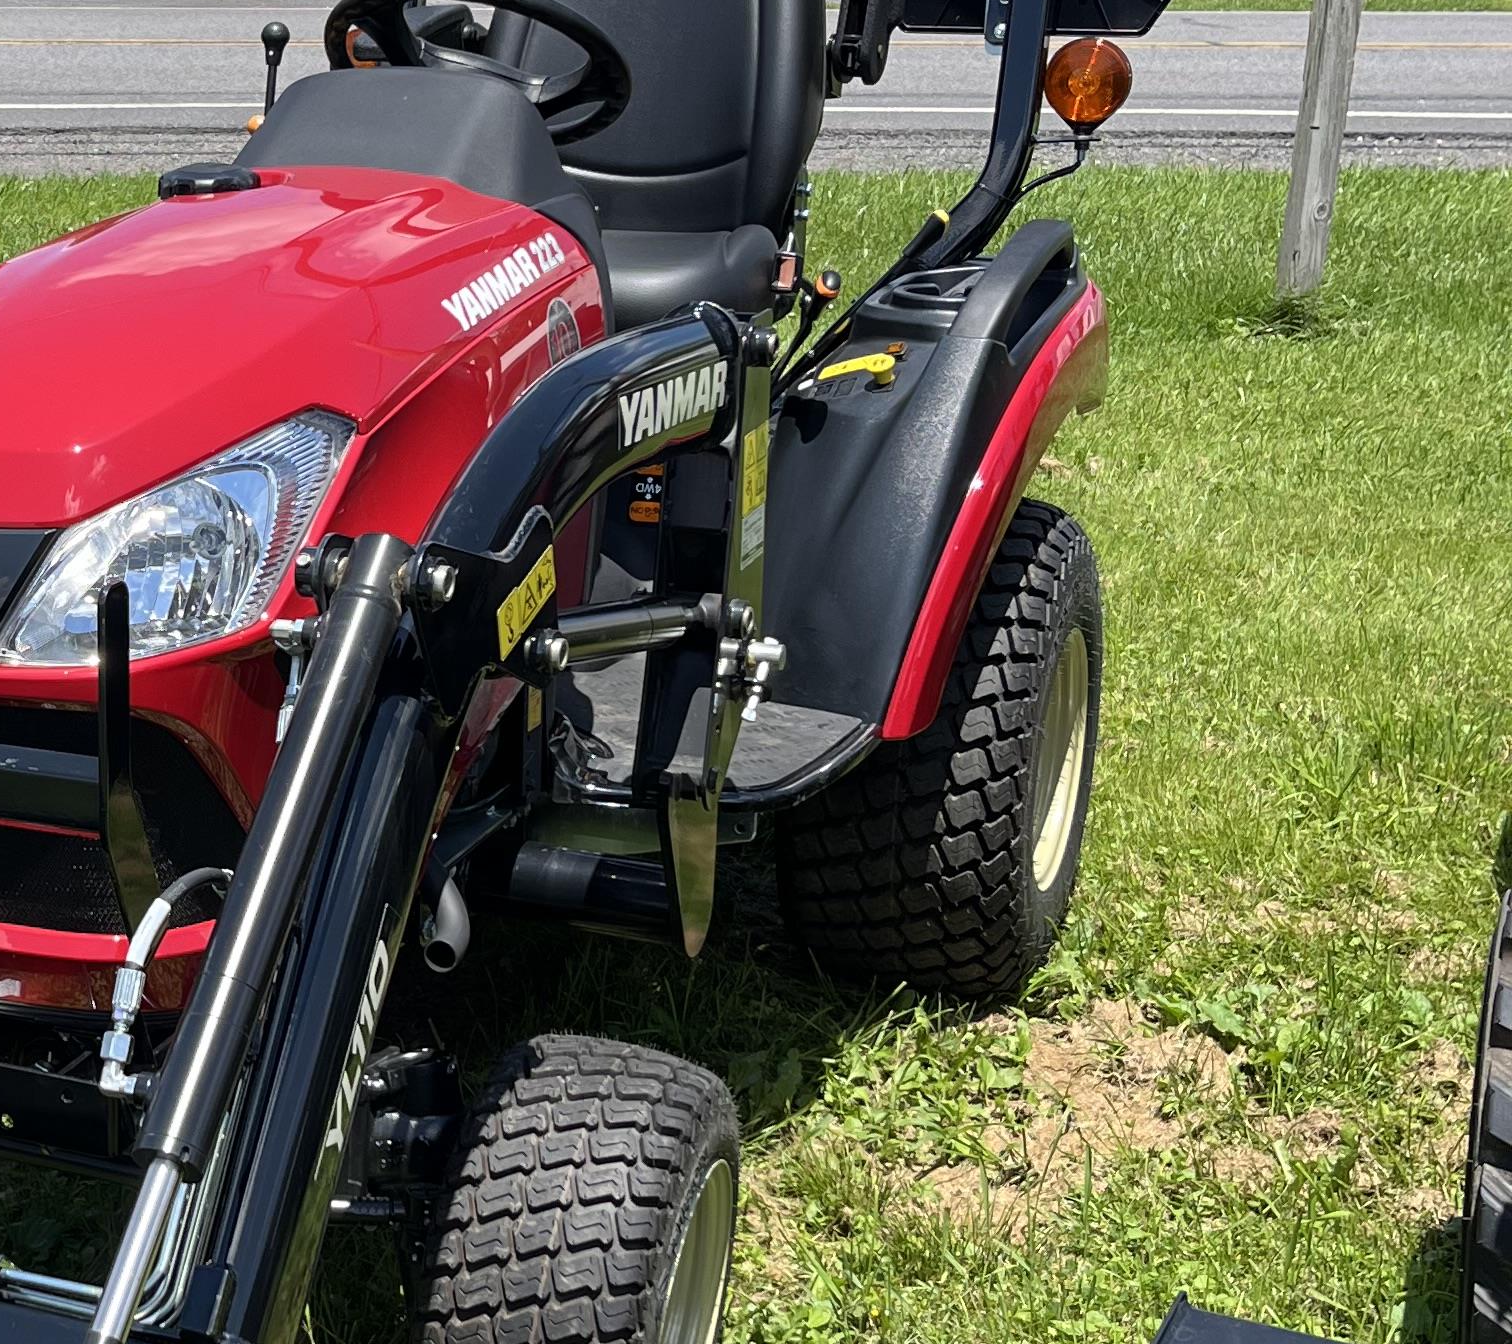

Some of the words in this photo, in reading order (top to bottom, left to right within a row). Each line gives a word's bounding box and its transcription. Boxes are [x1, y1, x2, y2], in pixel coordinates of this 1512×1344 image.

[441, 247, 541, 331] YANMAR
[529, 232, 565, 273] 223
[619, 360, 728, 447] YANMAR
[635, 483, 662, 494] 4WD
[325, 939, 389, 1152] YL110
